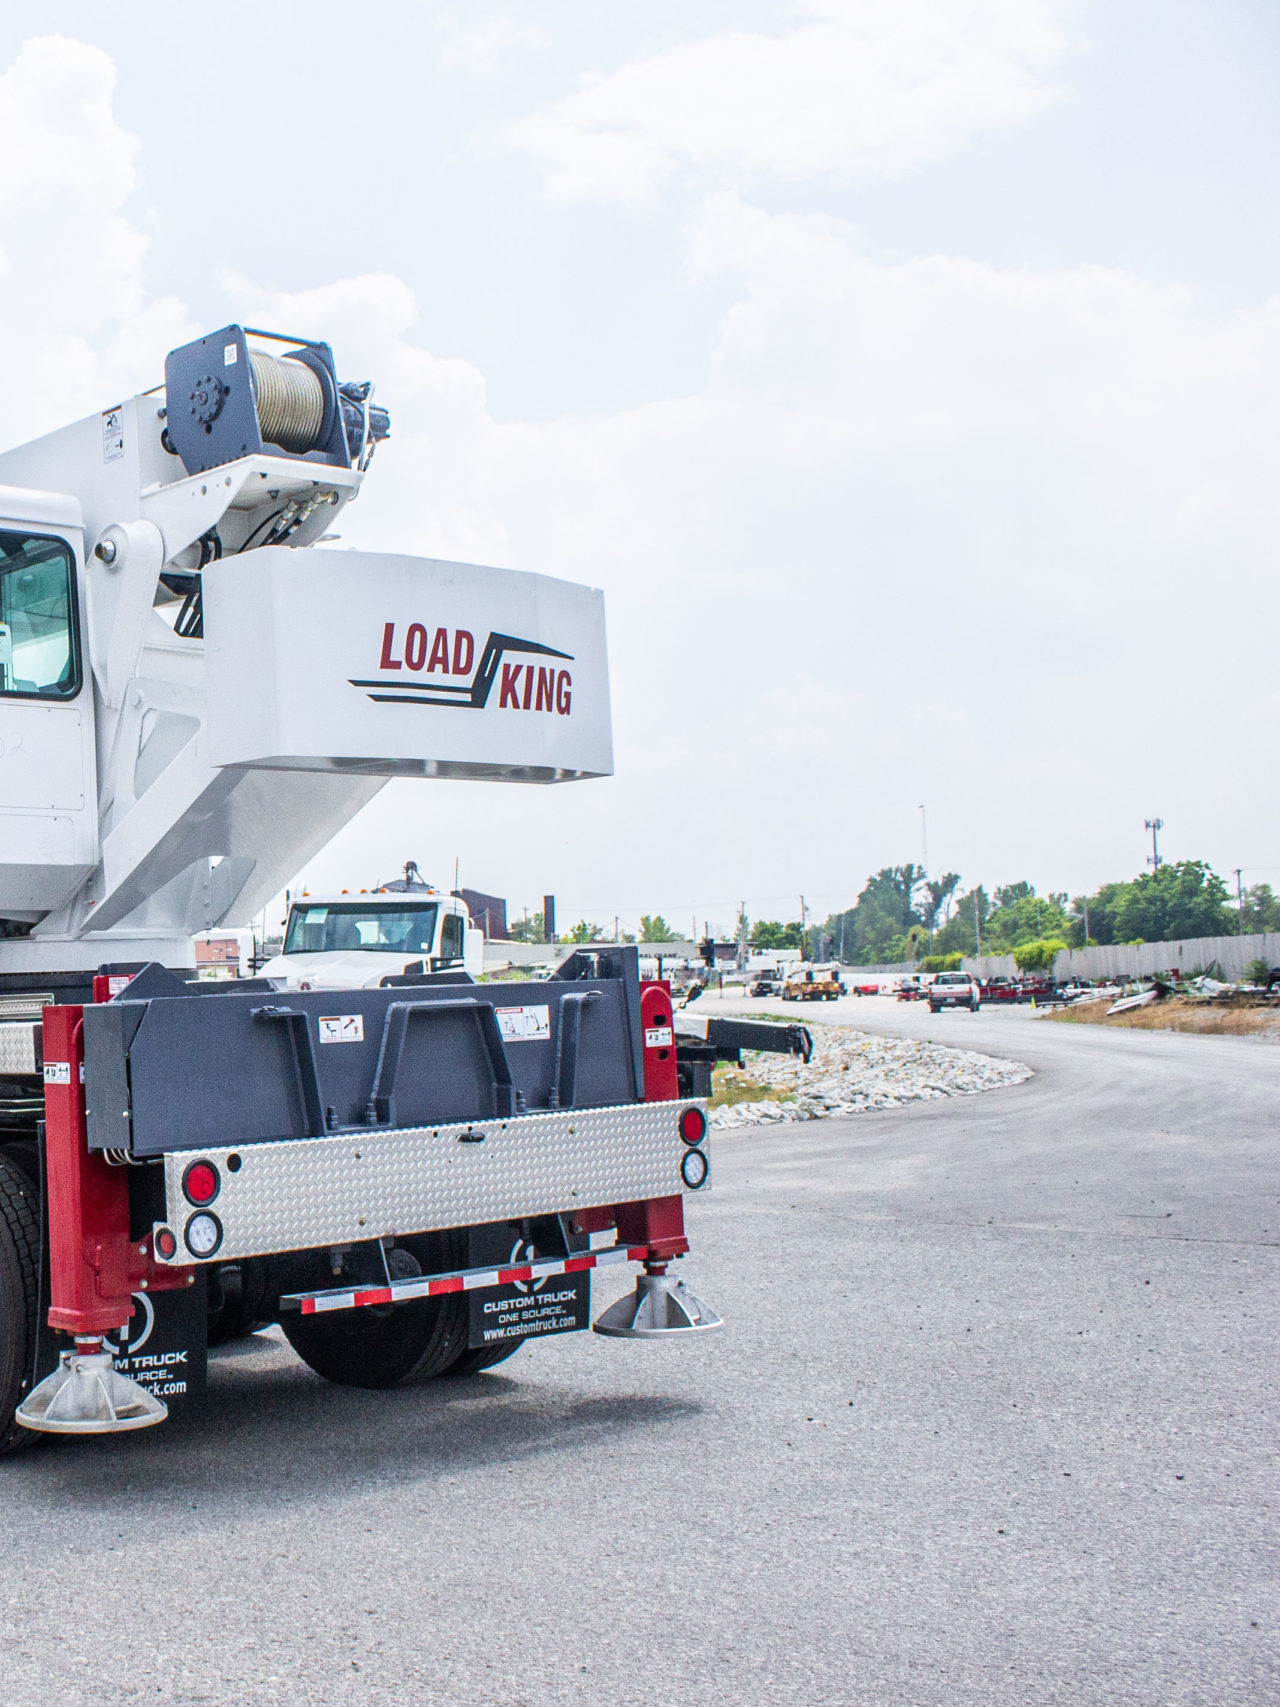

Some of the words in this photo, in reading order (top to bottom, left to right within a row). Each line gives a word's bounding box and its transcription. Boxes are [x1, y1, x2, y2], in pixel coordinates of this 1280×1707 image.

[379, 622, 474, 676] LOAD
[498, 662, 573, 716] KING
[483, 1295, 535, 1314] CUSTOM
[535, 1289, 577, 1305] TRUCK
[483, 1315, 576, 1341] www.customtruck.com
[498, 1312, 520, 1324] ONE
[131, 1350, 189, 1369] TRUCK
